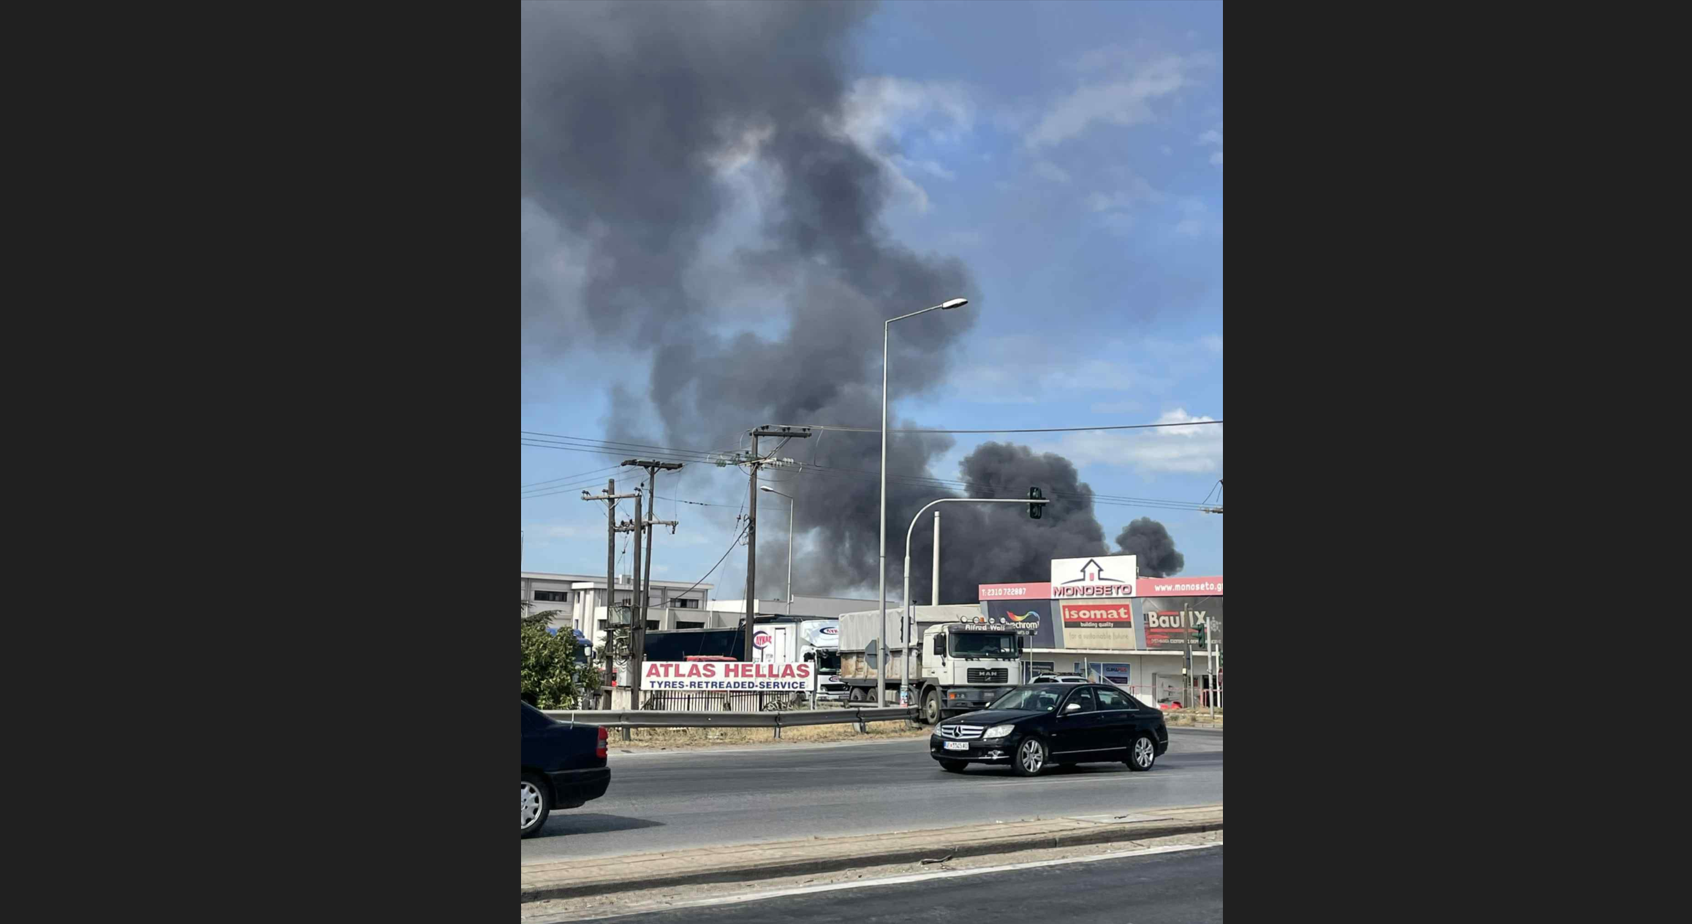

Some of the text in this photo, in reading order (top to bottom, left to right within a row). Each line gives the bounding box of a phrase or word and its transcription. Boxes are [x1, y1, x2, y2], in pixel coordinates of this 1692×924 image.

[1053, 584, 1132, 597] MONOSETO
[1065, 607, 1128, 619] isomat
[646, 663, 810, 678] ATLAS HELLAS
[650, 681, 806, 689] TYRES-RETREADED-SERVICE
